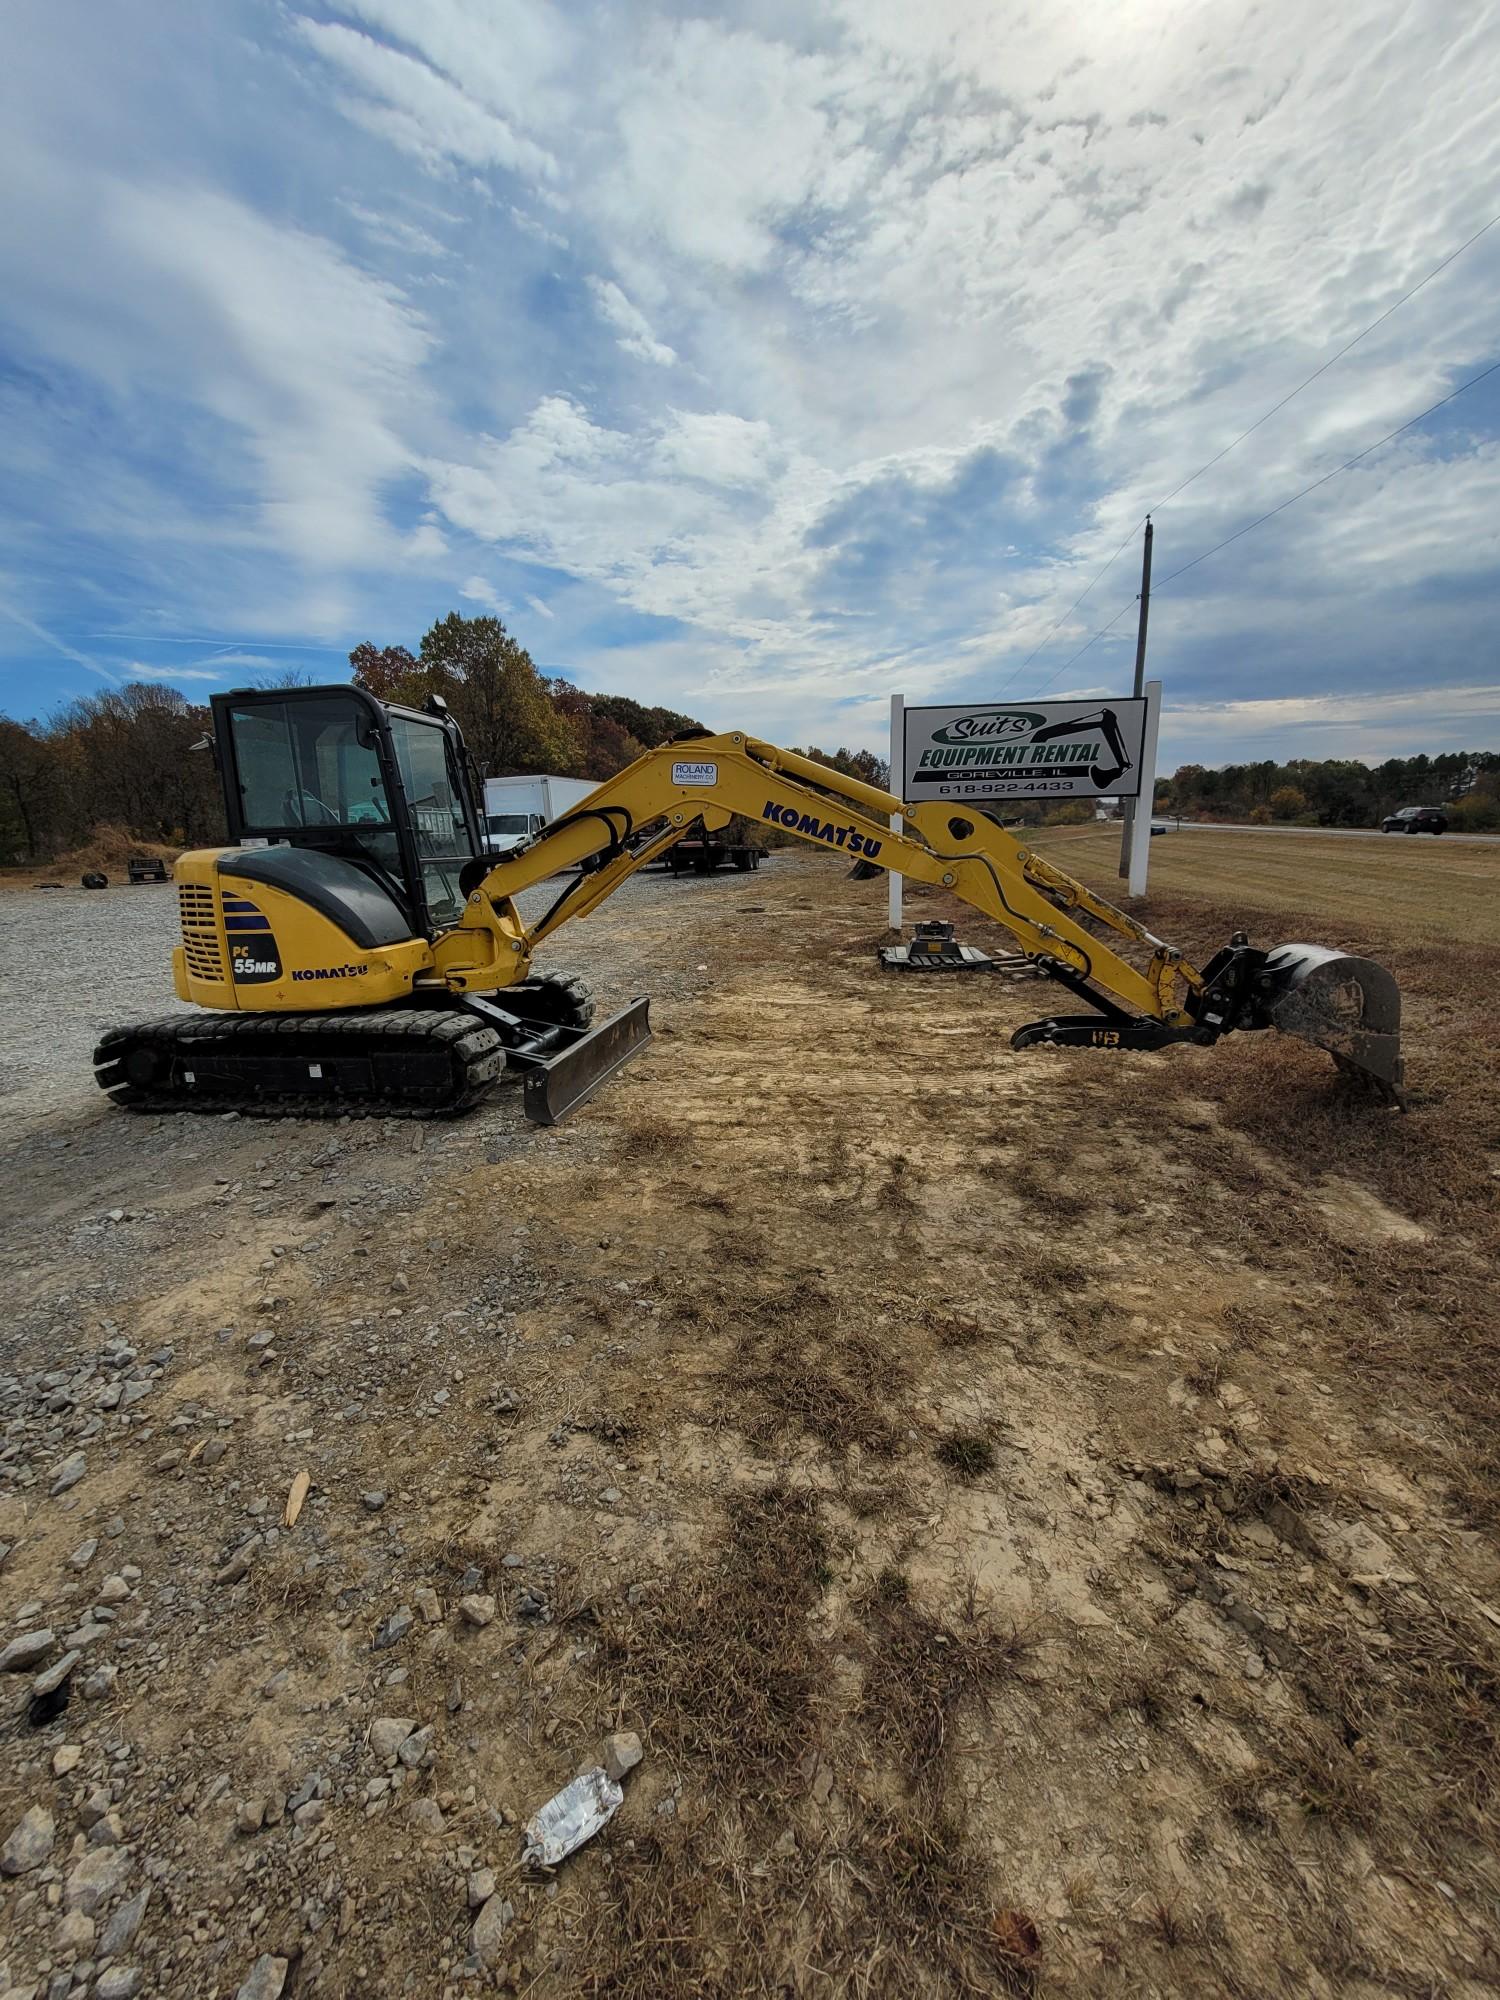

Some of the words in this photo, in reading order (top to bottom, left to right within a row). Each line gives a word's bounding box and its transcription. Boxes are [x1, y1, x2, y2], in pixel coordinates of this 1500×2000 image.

[949, 716, 1028, 740] Suits
[919, 746, 1029, 767] EQUIPMENT
[1031, 743, 1100, 763] RENTAL
[675, 764, 714, 774] ROLAND
[939, 781, 1074, 795] 618-922-4433
[762, 800, 882, 859] KOMATSU
[232, 946, 249, 957] PC
[234, 958, 277, 974] 55MR
[292, 964, 368, 981] KOMATSU
